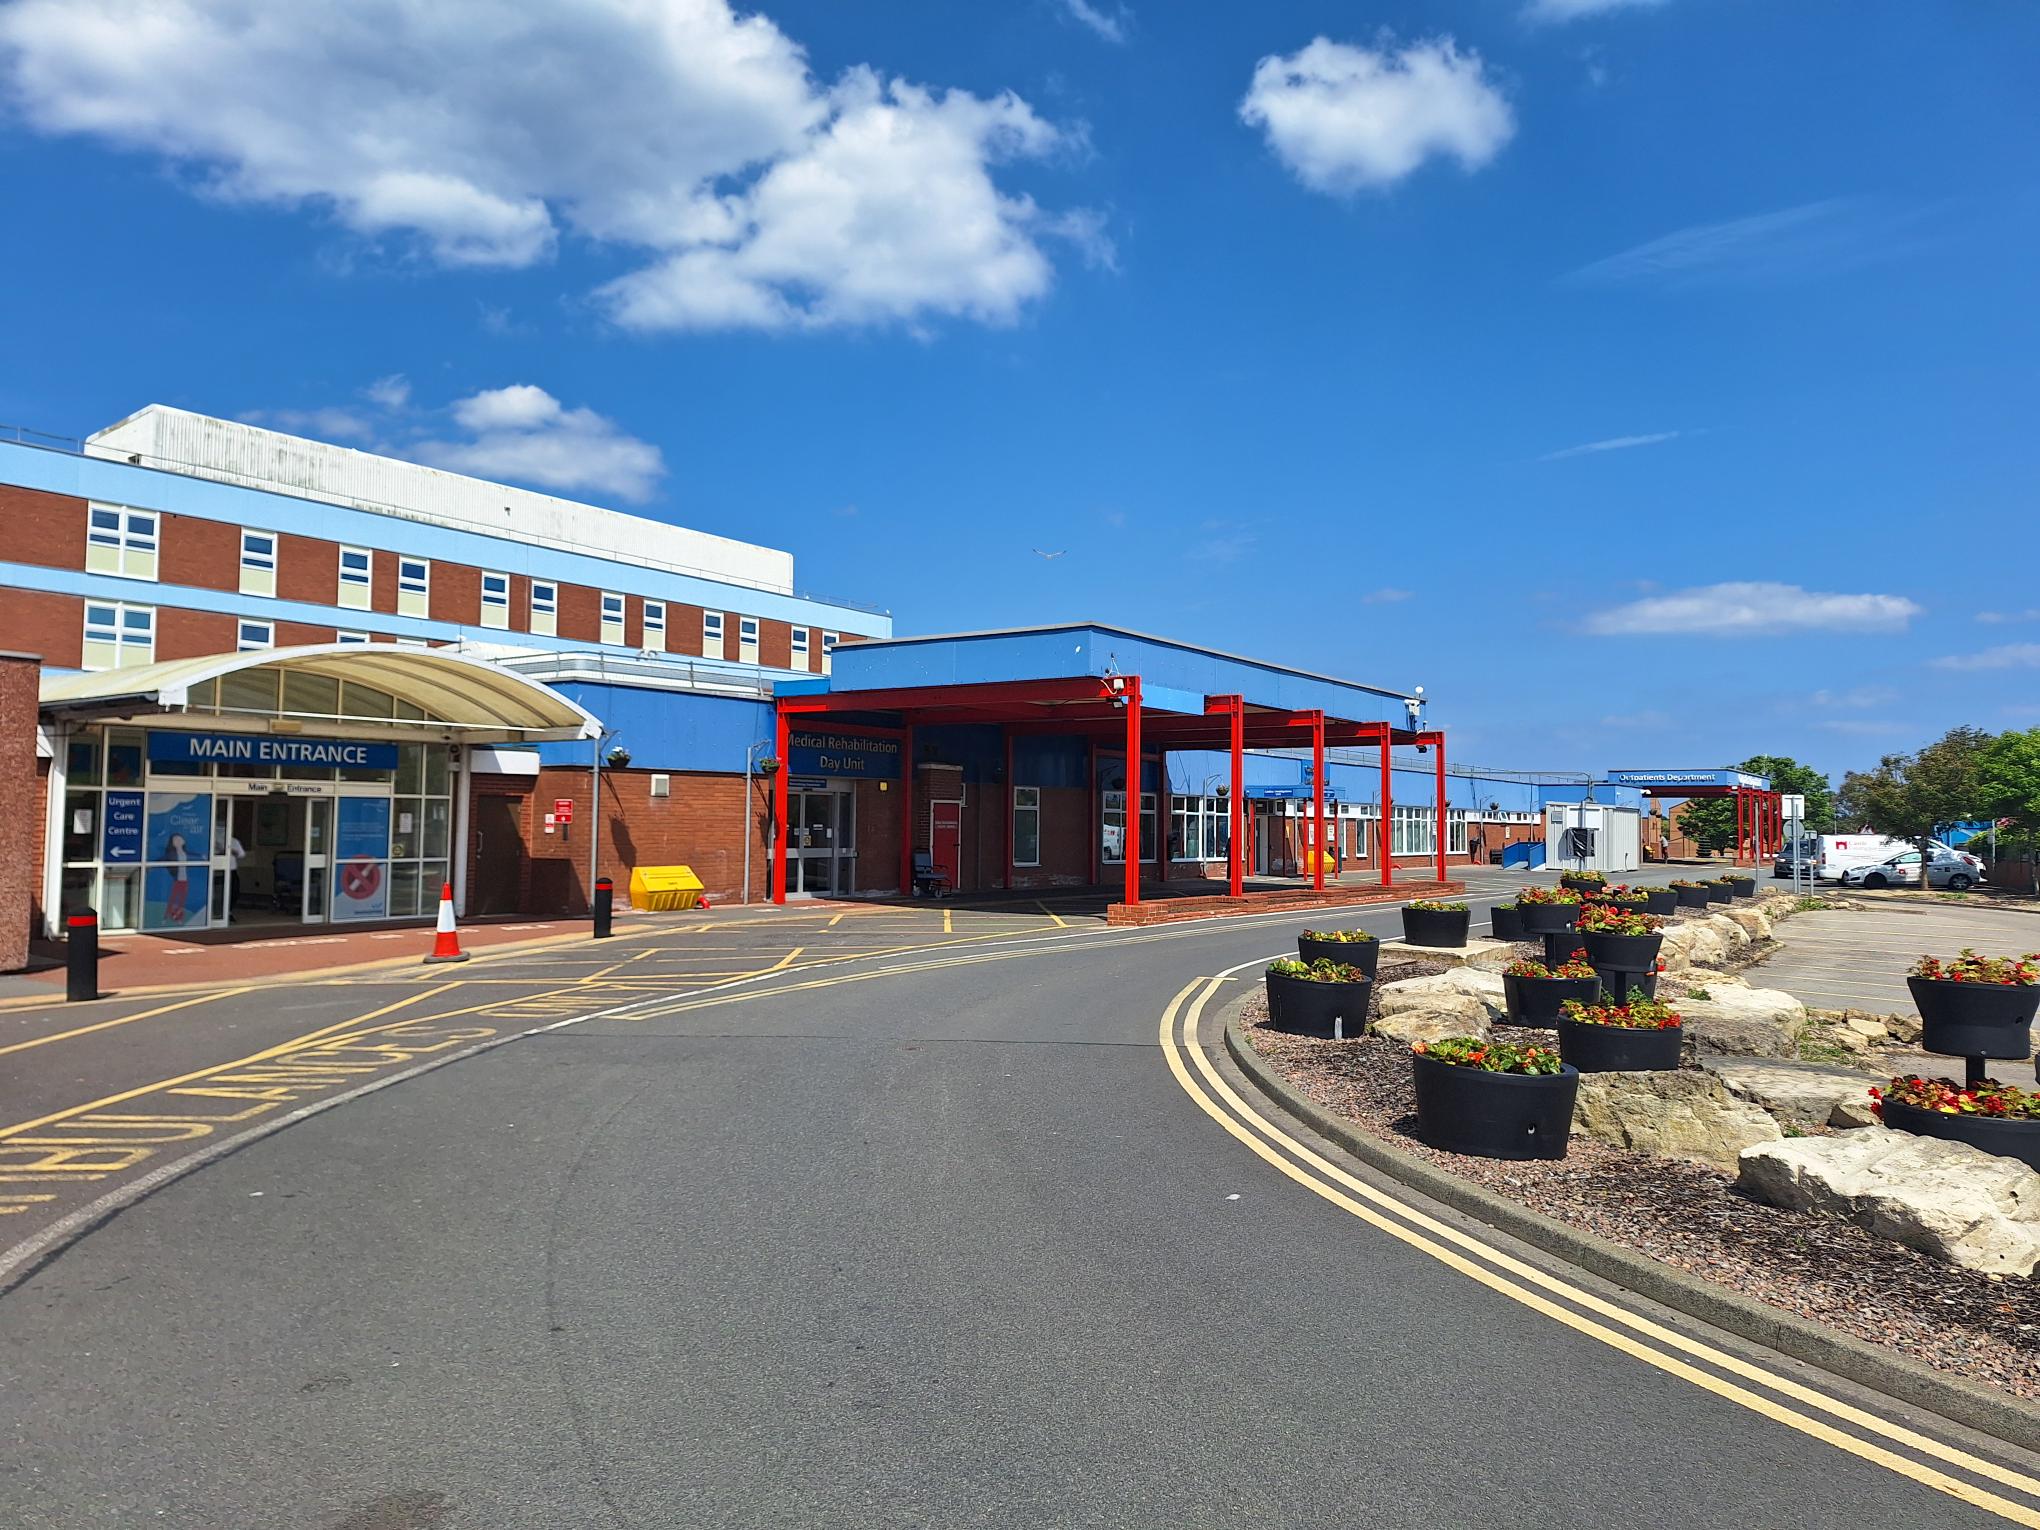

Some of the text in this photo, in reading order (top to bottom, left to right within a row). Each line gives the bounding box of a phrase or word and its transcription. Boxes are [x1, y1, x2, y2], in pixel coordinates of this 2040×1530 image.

[828, 737, 897, 753] Rehabilitation
[190, 738, 367, 763] MAIN ENTRANCE
[820, 755, 865, 772] Day Unit
[1619, 773, 1716, 782] Outpatients Department
[248, 783, 322, 792] Main Entrance
[108, 797, 140, 807] Urgent
[113, 812, 134, 820] Care
[108, 827, 139, 835] Centre
[476, 984, 683, 1018] ONLY
